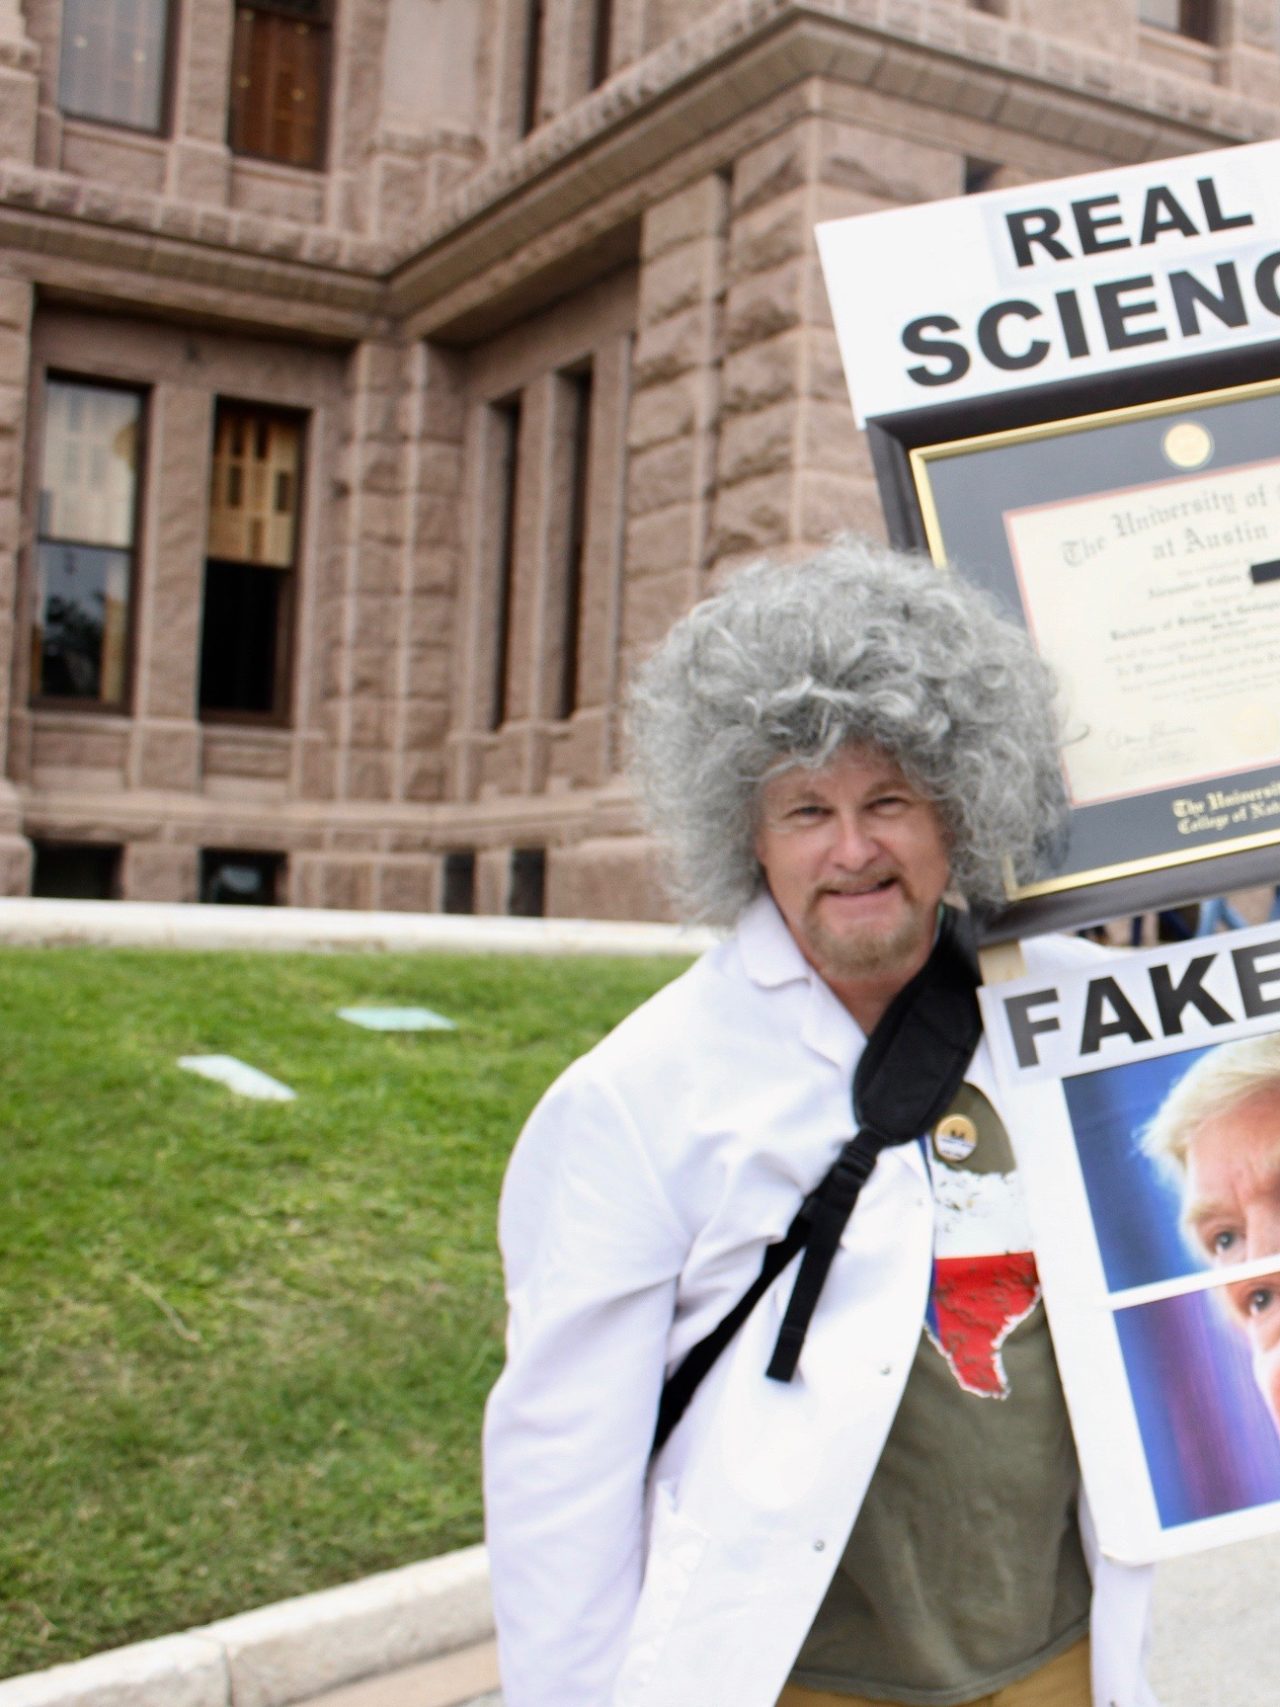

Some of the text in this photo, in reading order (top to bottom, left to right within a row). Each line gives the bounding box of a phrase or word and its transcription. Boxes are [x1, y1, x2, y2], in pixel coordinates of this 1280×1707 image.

[1005, 177, 1254, 267] REAL
[1061, 535, 1106, 567] The
[1112, 488, 1236, 538] University
[1246, 484, 1266, 507] of
[1152, 524, 1268, 560] at Austin
[1172, 798, 1206, 818] The
[1177, 813, 1229, 835] College
[1231, 806, 1248, 823] of
